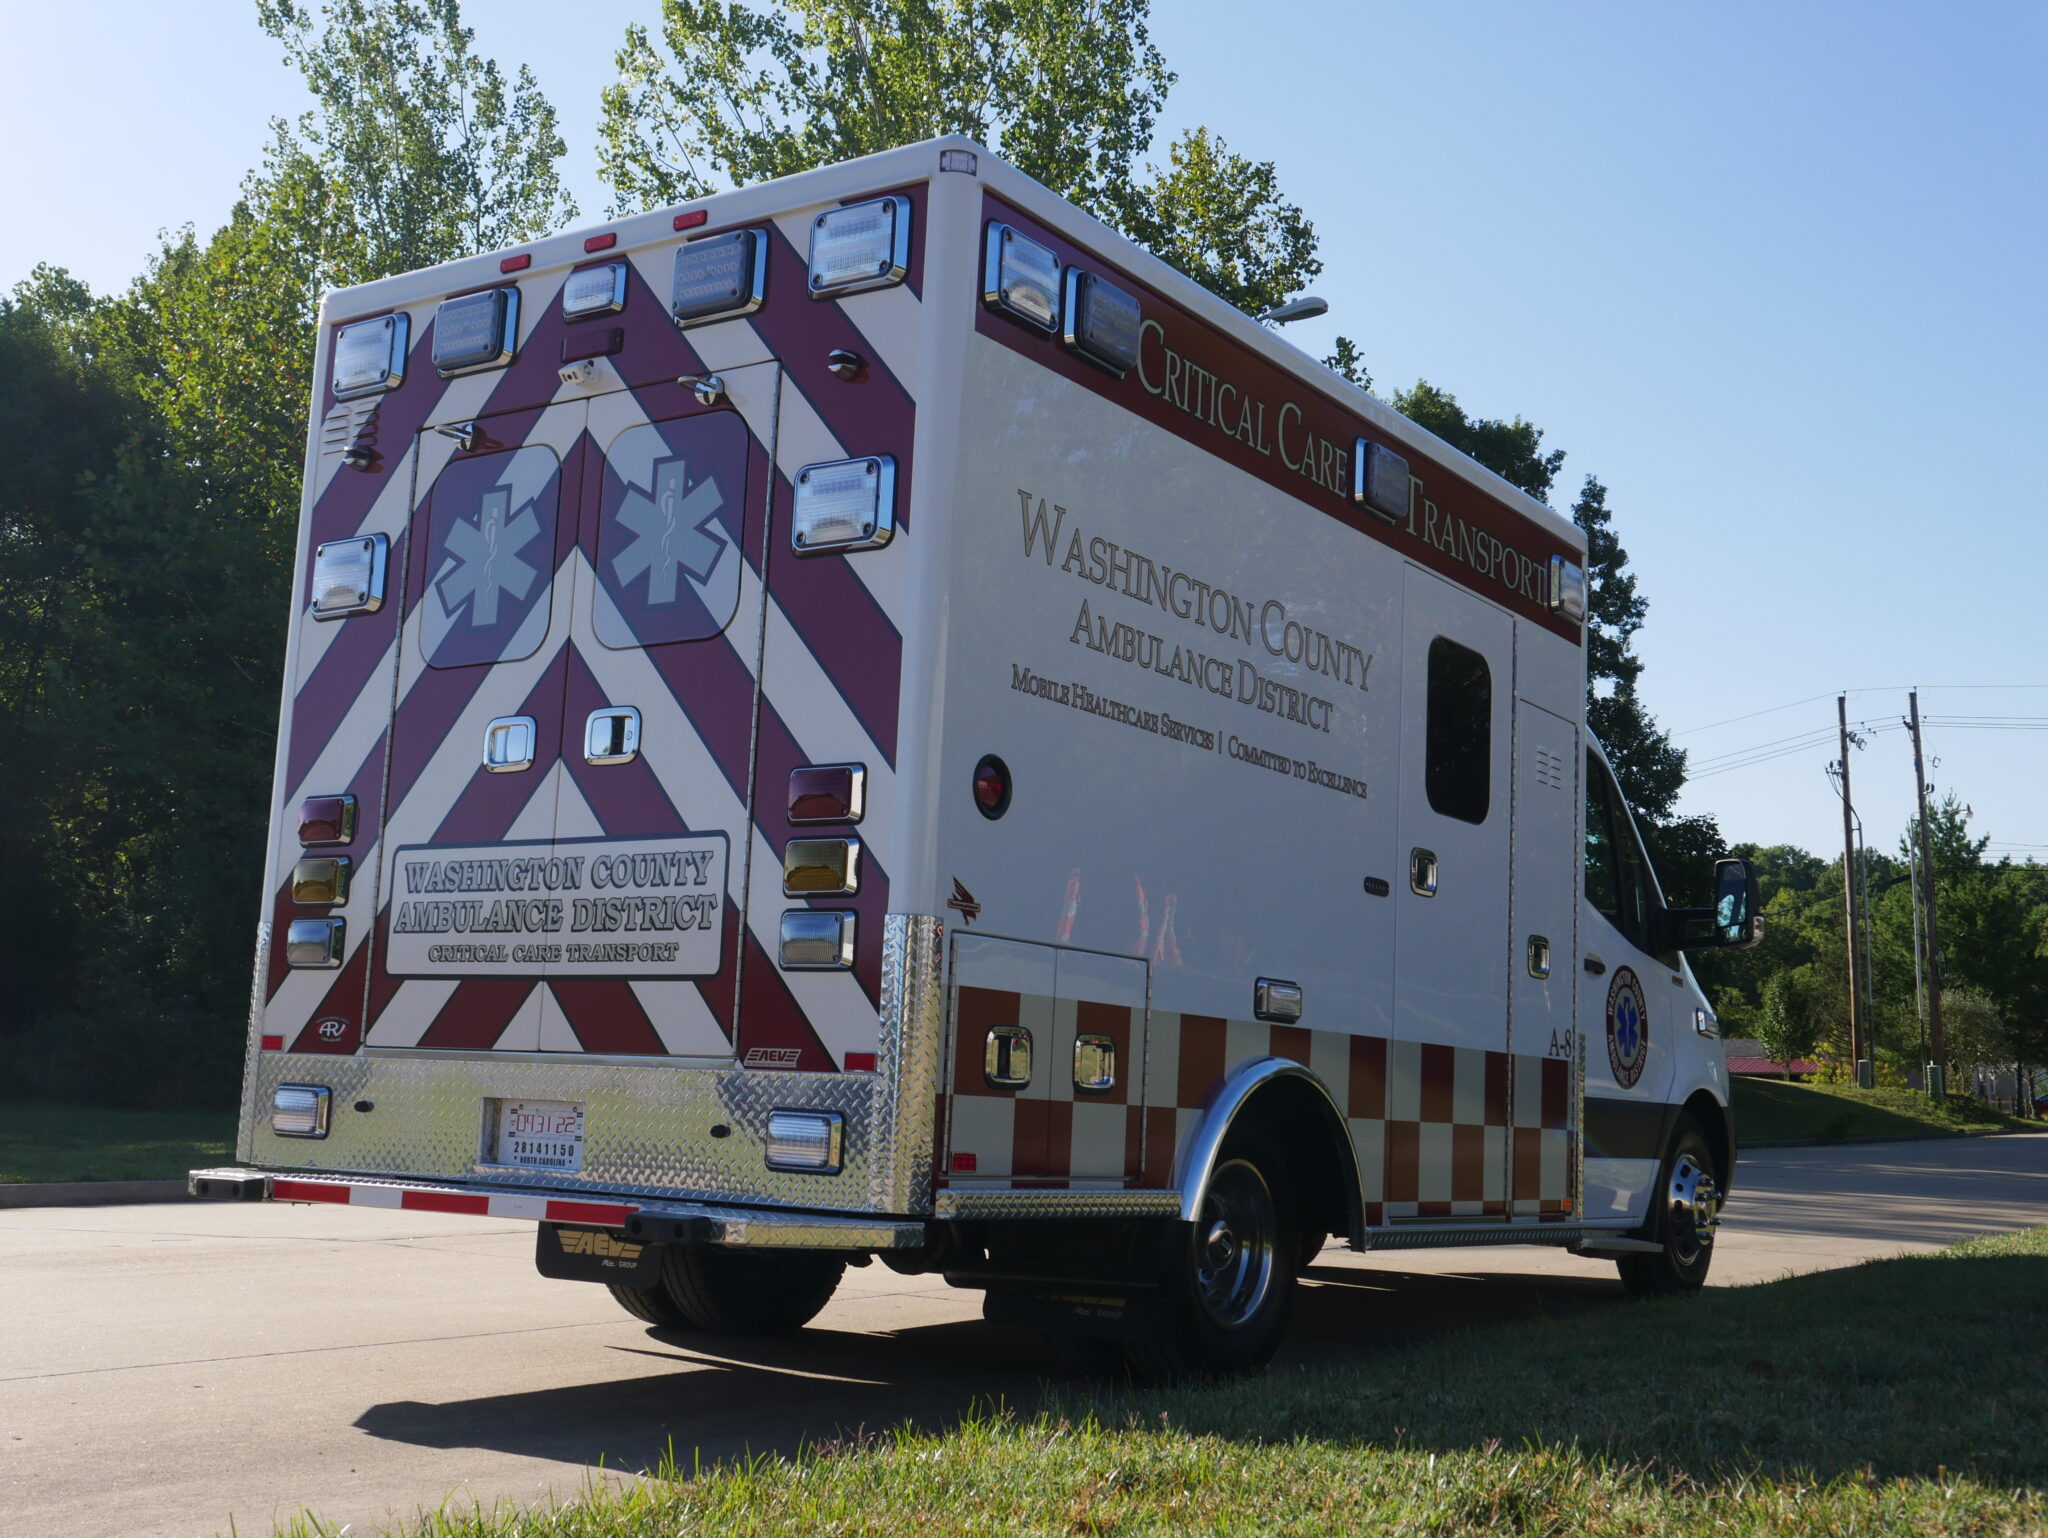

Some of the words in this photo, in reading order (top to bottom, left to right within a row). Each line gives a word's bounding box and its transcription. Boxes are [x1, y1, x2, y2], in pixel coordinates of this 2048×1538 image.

[1137, 319, 1271, 456] CRITICAL
[1278, 402, 1348, 498] CARE
[1405, 473, 1546, 605] TRANSPORT
[1018, 488, 1254, 645] WASHINGTON
[1260, 600, 1373, 692] COUNTY
[1069, 599, 1233, 699] AMBULANCE
[1238, 659, 1333, 733] DISTRICT
[1011, 664, 1070, 706] MOBILE
[1071, 683, 1159, 734] HEALTHCARE
[1160, 713, 1214, 751] SERVICES
[1228, 735, 1291, 775] COMMITTED
[1293, 760, 1306, 780] TO
[1307, 760, 1367, 799] EXCELLENCE
[405, 856, 584, 893] WASHINGTON
[591, 850, 713, 888] COUNTY
[394, 899, 563, 933] AMBULANCE
[571, 894, 718, 932] DISTRICT
[429, 944, 508, 963] CRITICAL
[513, 944, 562, 963] CARE
[566, 943, 679, 963] TRANSPORT
[1549, 1027, 1572, 1058] A-8
[514, 1141, 574, 1157] 28141150
[520, 1156, 537, 1165] NORTH
[539, 1157, 566, 1166] CAROLINA
[619, 1260, 637, 1269] GROUP
